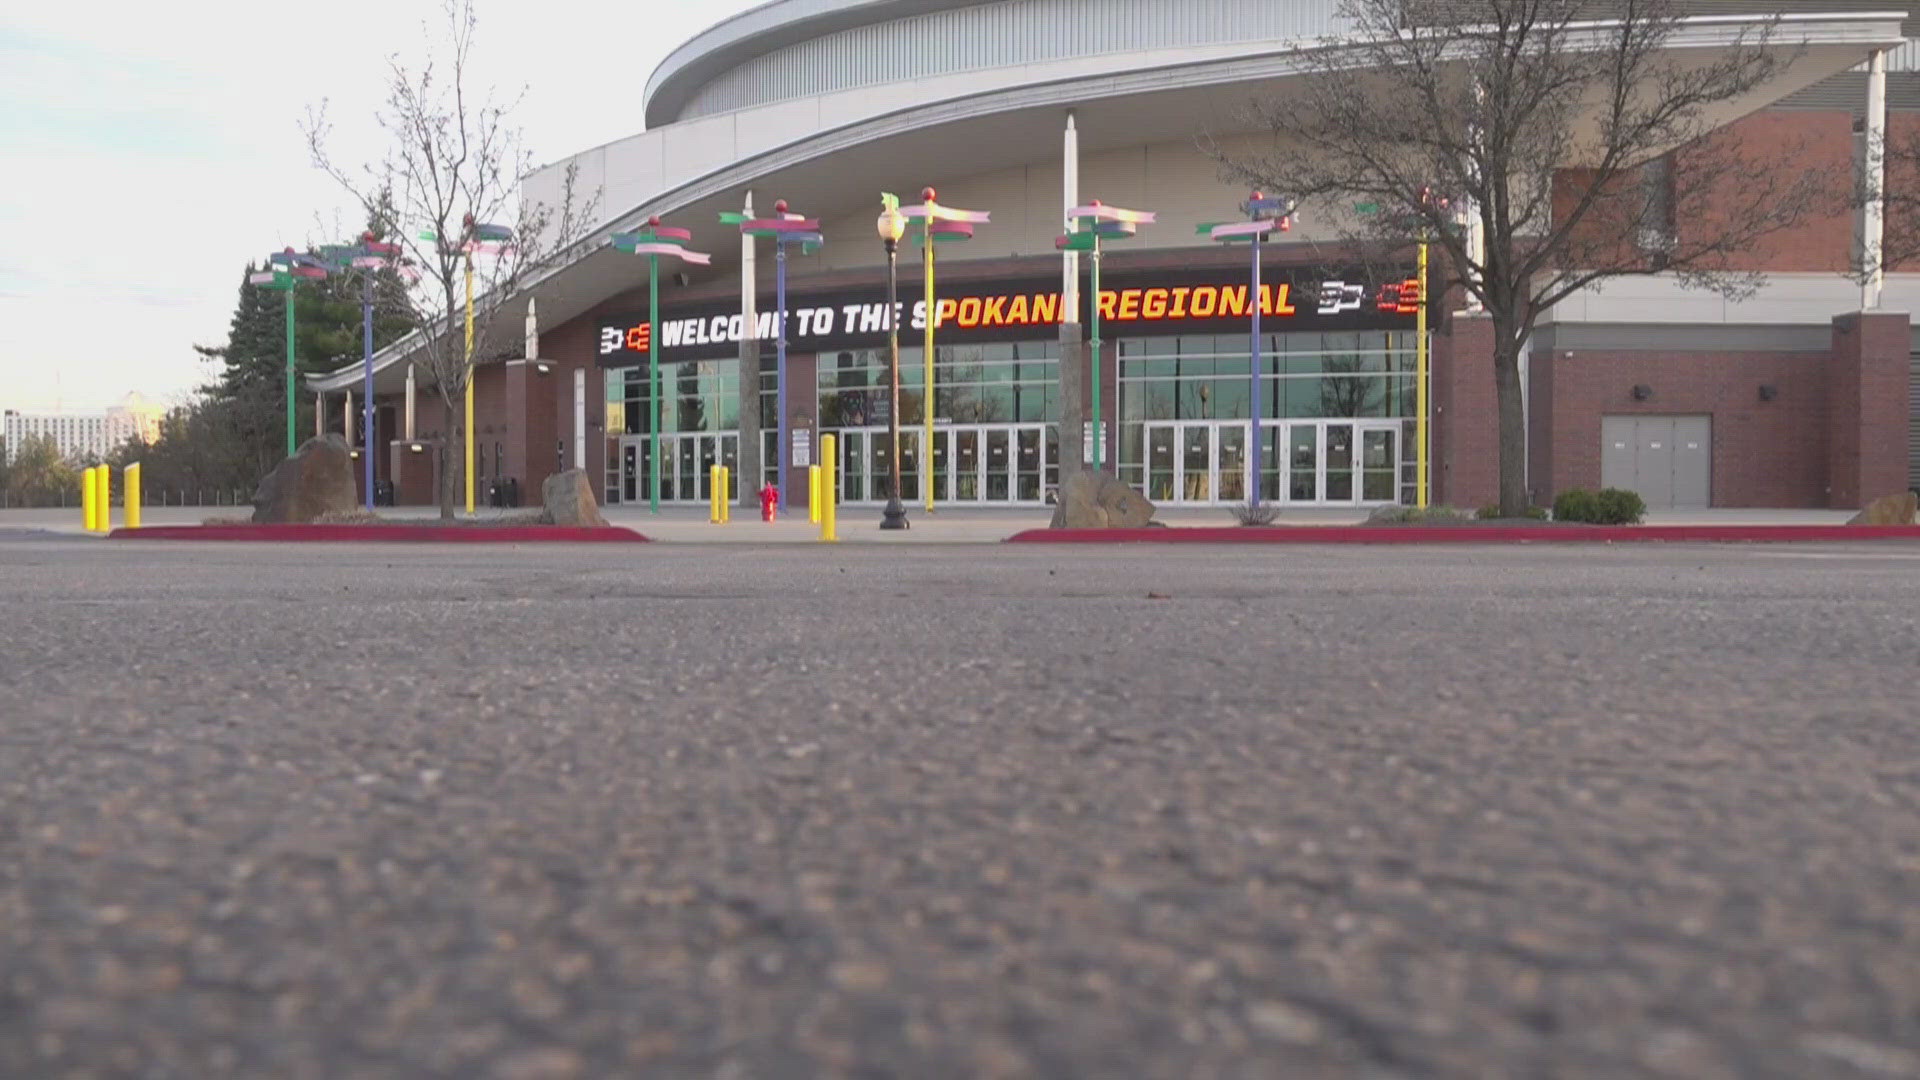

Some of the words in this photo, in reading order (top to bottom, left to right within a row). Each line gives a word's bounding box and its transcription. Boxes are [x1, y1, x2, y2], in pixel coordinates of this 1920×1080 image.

[661, 310, 789, 348] WELCOME
[796, 306, 834, 336] TO
[842, 301, 904, 335] THE
[1094, 283, 1296, 321] REGIONAL
